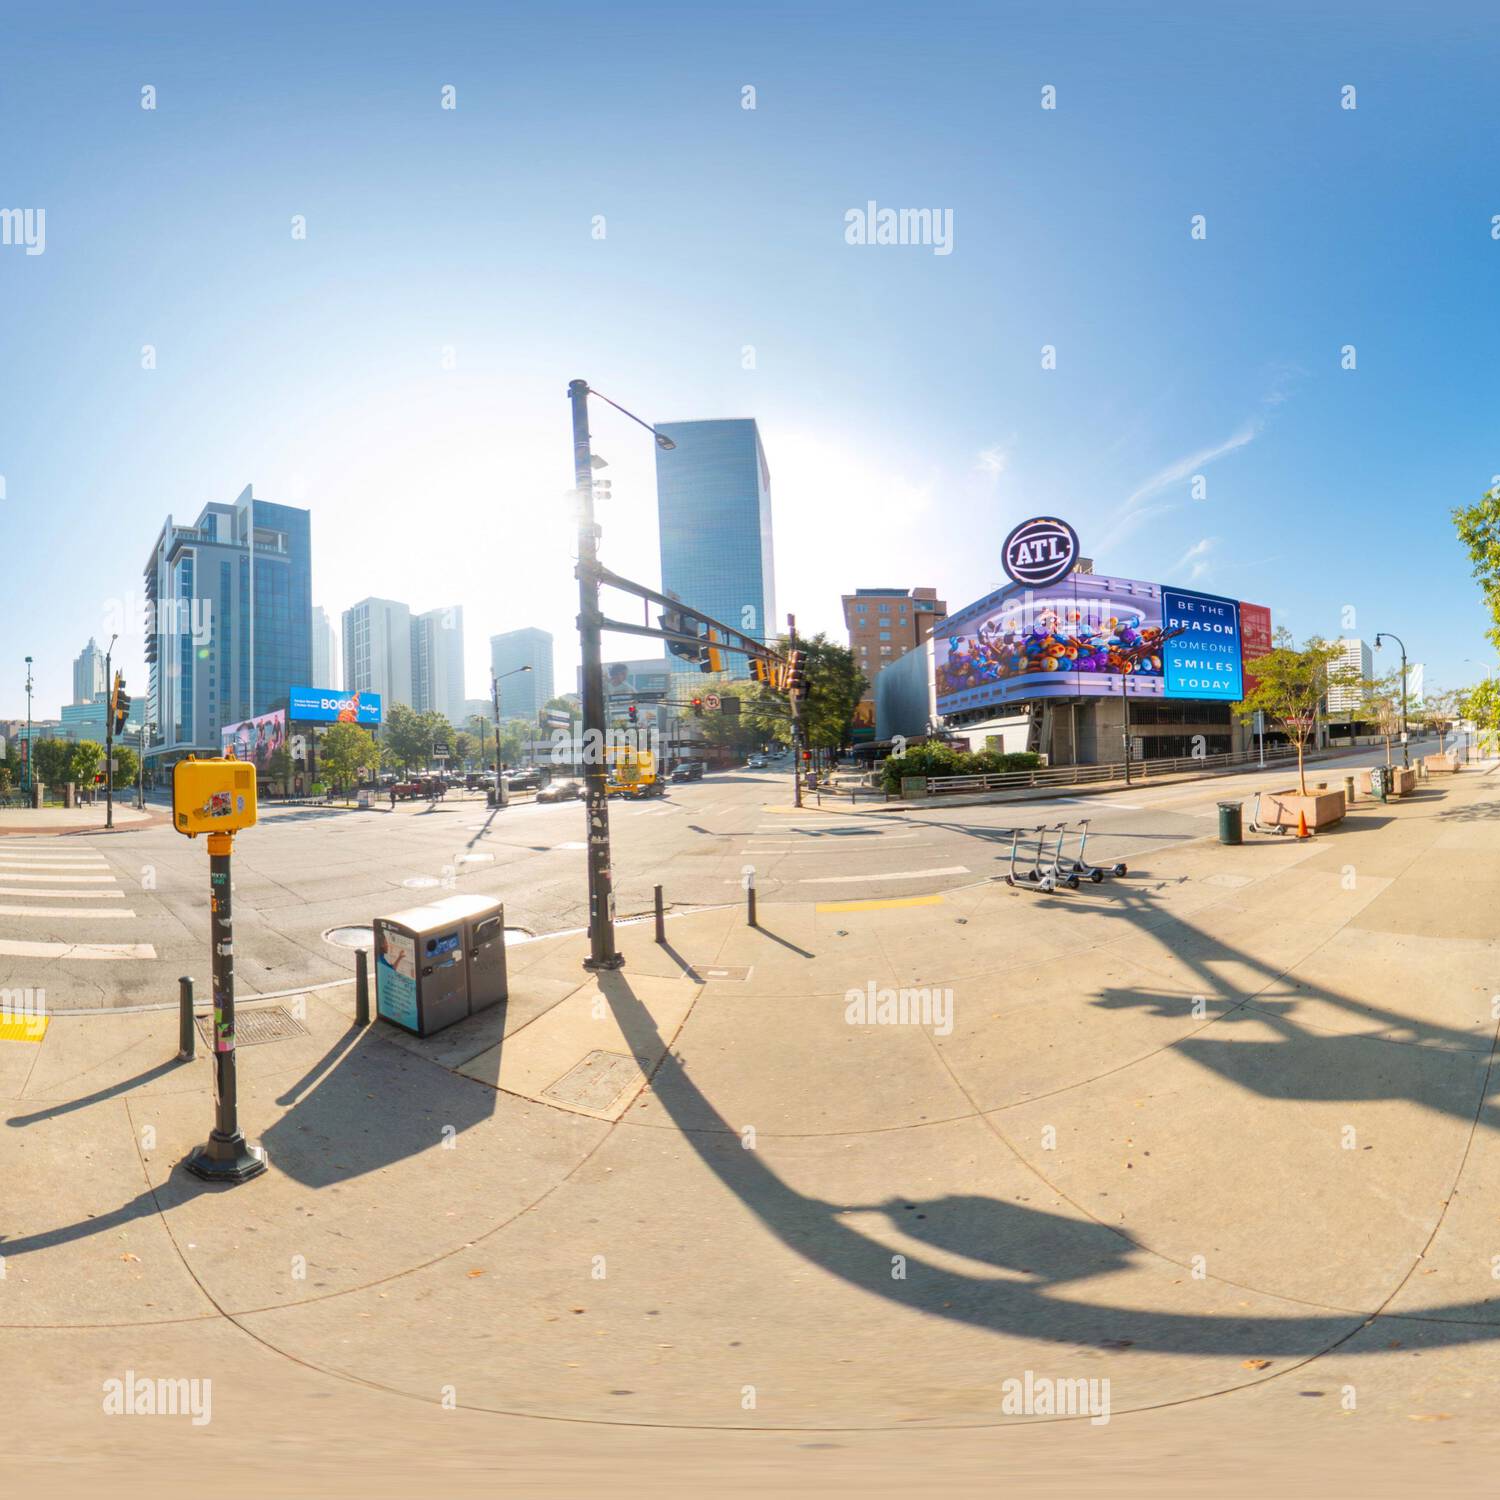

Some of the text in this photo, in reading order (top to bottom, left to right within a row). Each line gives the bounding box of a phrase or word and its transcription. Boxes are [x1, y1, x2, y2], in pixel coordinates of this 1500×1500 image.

[1016, 537, 1064, 566] ATL
[1178, 601, 1224, 616] BE THE
[1169, 618, 1233, 634] REASON
[1170, 639, 1233, 653] SOMEONE
[1174, 659, 1233, 672] SMILES
[1178, 678, 1230, 689] TODAY
[320, 698, 355, 710] BOGO
